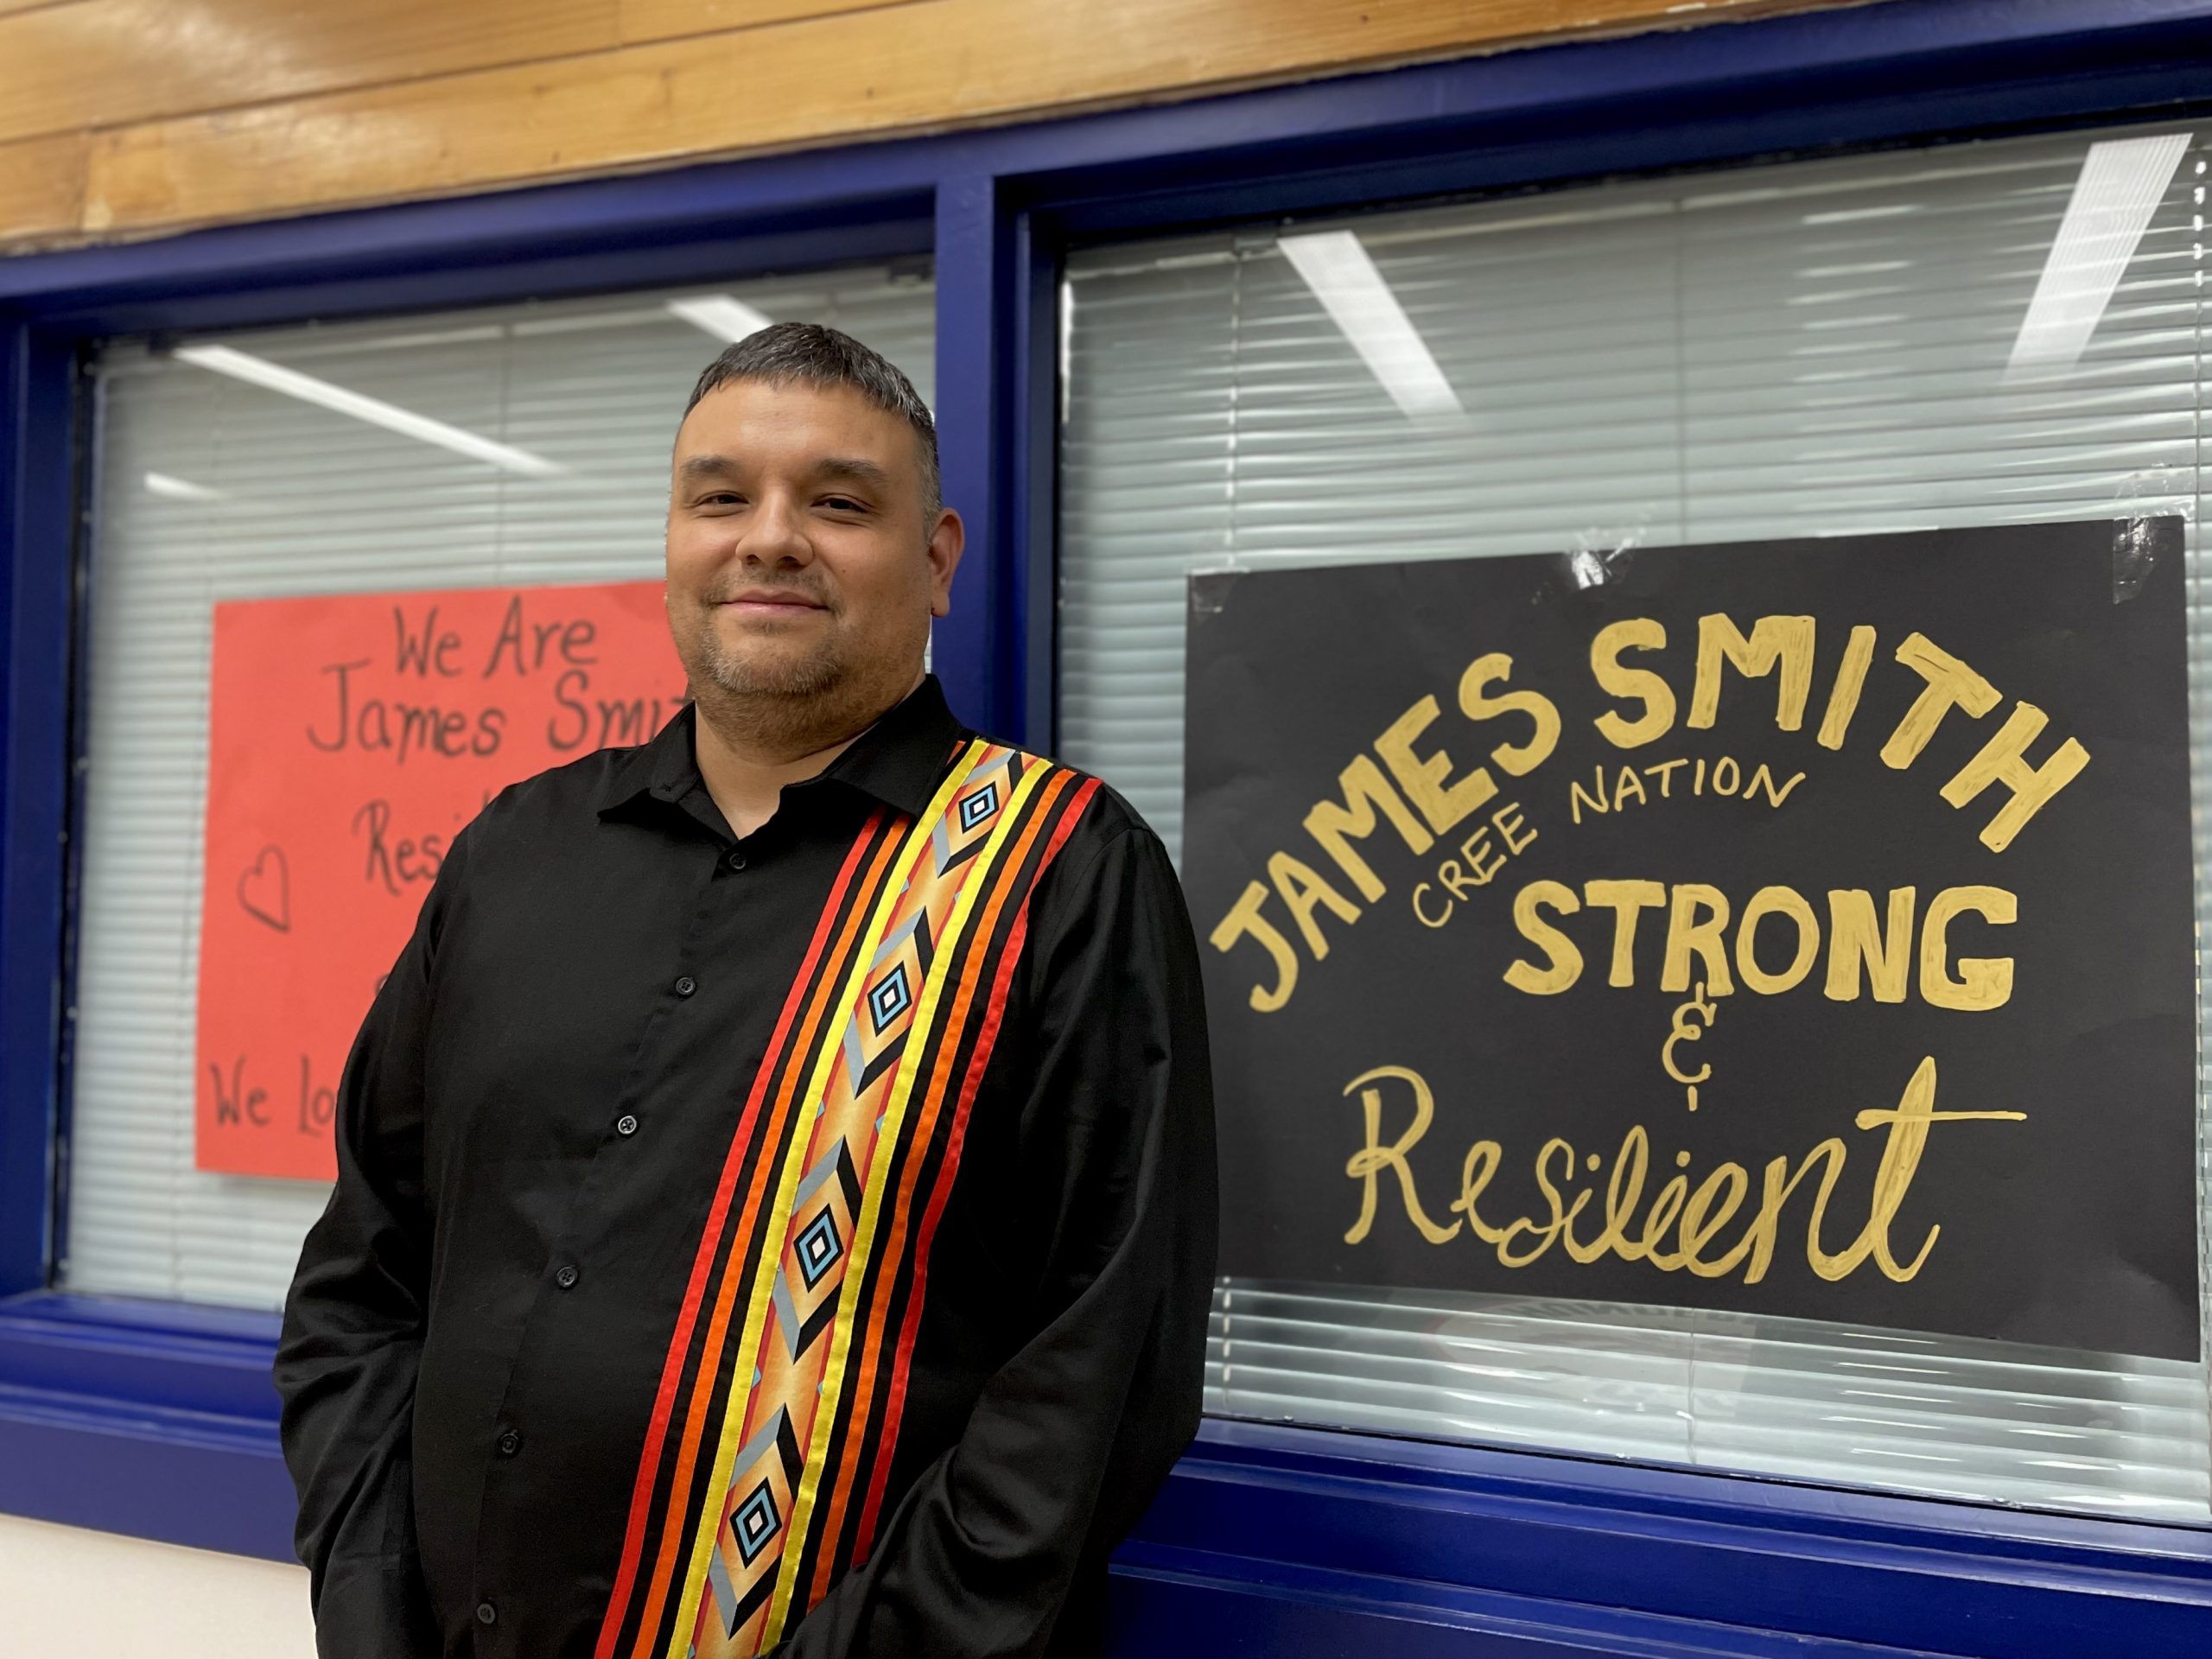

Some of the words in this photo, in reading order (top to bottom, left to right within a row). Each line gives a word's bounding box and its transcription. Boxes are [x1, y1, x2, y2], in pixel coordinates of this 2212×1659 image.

[394, 606, 464, 677] We
[482, 594, 599, 678] Are
[306, 658, 506, 766] James
[549, 669, 691, 752] Smi
[1211, 653, 1561, 1012] JAMES
[1591, 613, 2091, 853] SMITH
[1413, 803, 1537, 927] CREE
[1571, 757, 1806, 823] NATION
[1503, 880, 2018, 1012] STRONG
[209, 1055, 271, 1128] We
[297, 1053, 335, 1138] Lo
[1662, 982, 1717, 1111] &
[1345, 1056, 2026, 1284] Resilient
